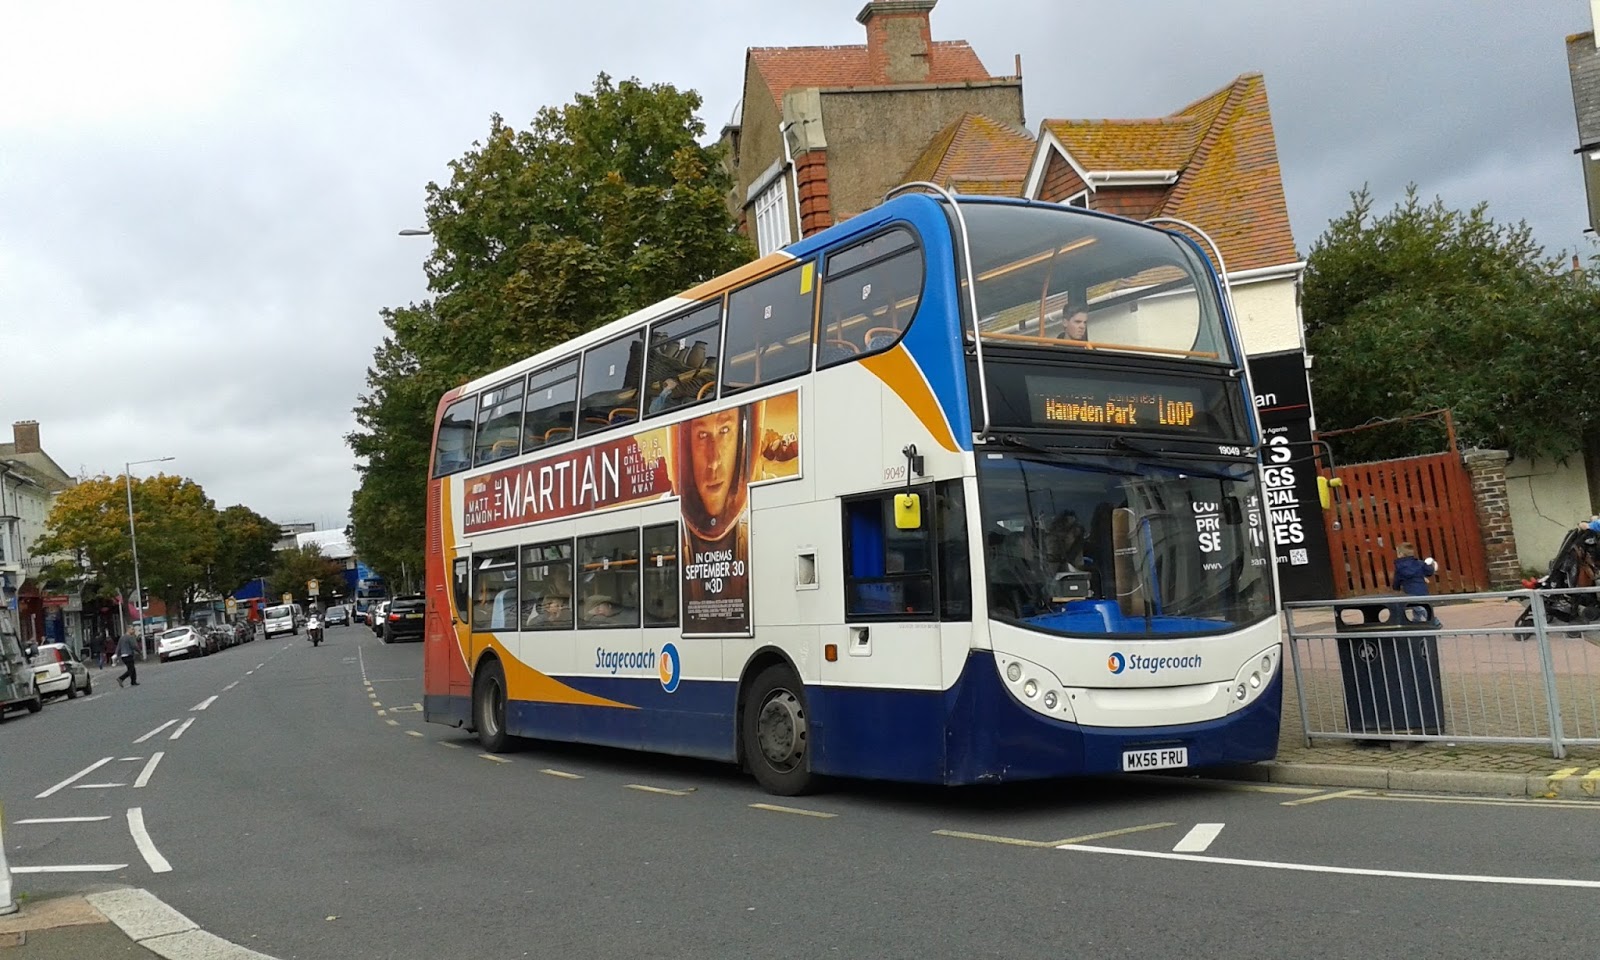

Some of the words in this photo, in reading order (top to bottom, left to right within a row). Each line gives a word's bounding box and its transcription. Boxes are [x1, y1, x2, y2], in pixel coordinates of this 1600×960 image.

[1106, 401, 1137, 425] Park
[627, 441, 647, 454] HELP
[650, 438, 658, 449] IS
[1218, 445, 1240, 456] 19049
[624, 452, 644, 466] ONLY
[627, 459, 660, 475] MILLION
[631, 470, 655, 484] MILES
[884, 465, 906, 481] 19049
[503, 447, 620, 520] MARTIAN
[632, 481, 654, 494] AWAY
[468, 497, 489, 513] MATT
[494, 478, 502, 521] THE
[465, 509, 493, 526] DAMON
[695, 552, 704, 564] IN
[704, 549, 733, 563] CINEMAS
[685, 561, 731, 580] SEPTEMBER
[732, 560, 745, 577] 30
[710, 577, 723, 594] 3D
[595, 646, 656, 675] Stagecoach
[1128, 653, 1203, 674] Stagecoach
[1127, 751, 1158, 769] MX56
[1160, 749, 1184, 766] FRU
